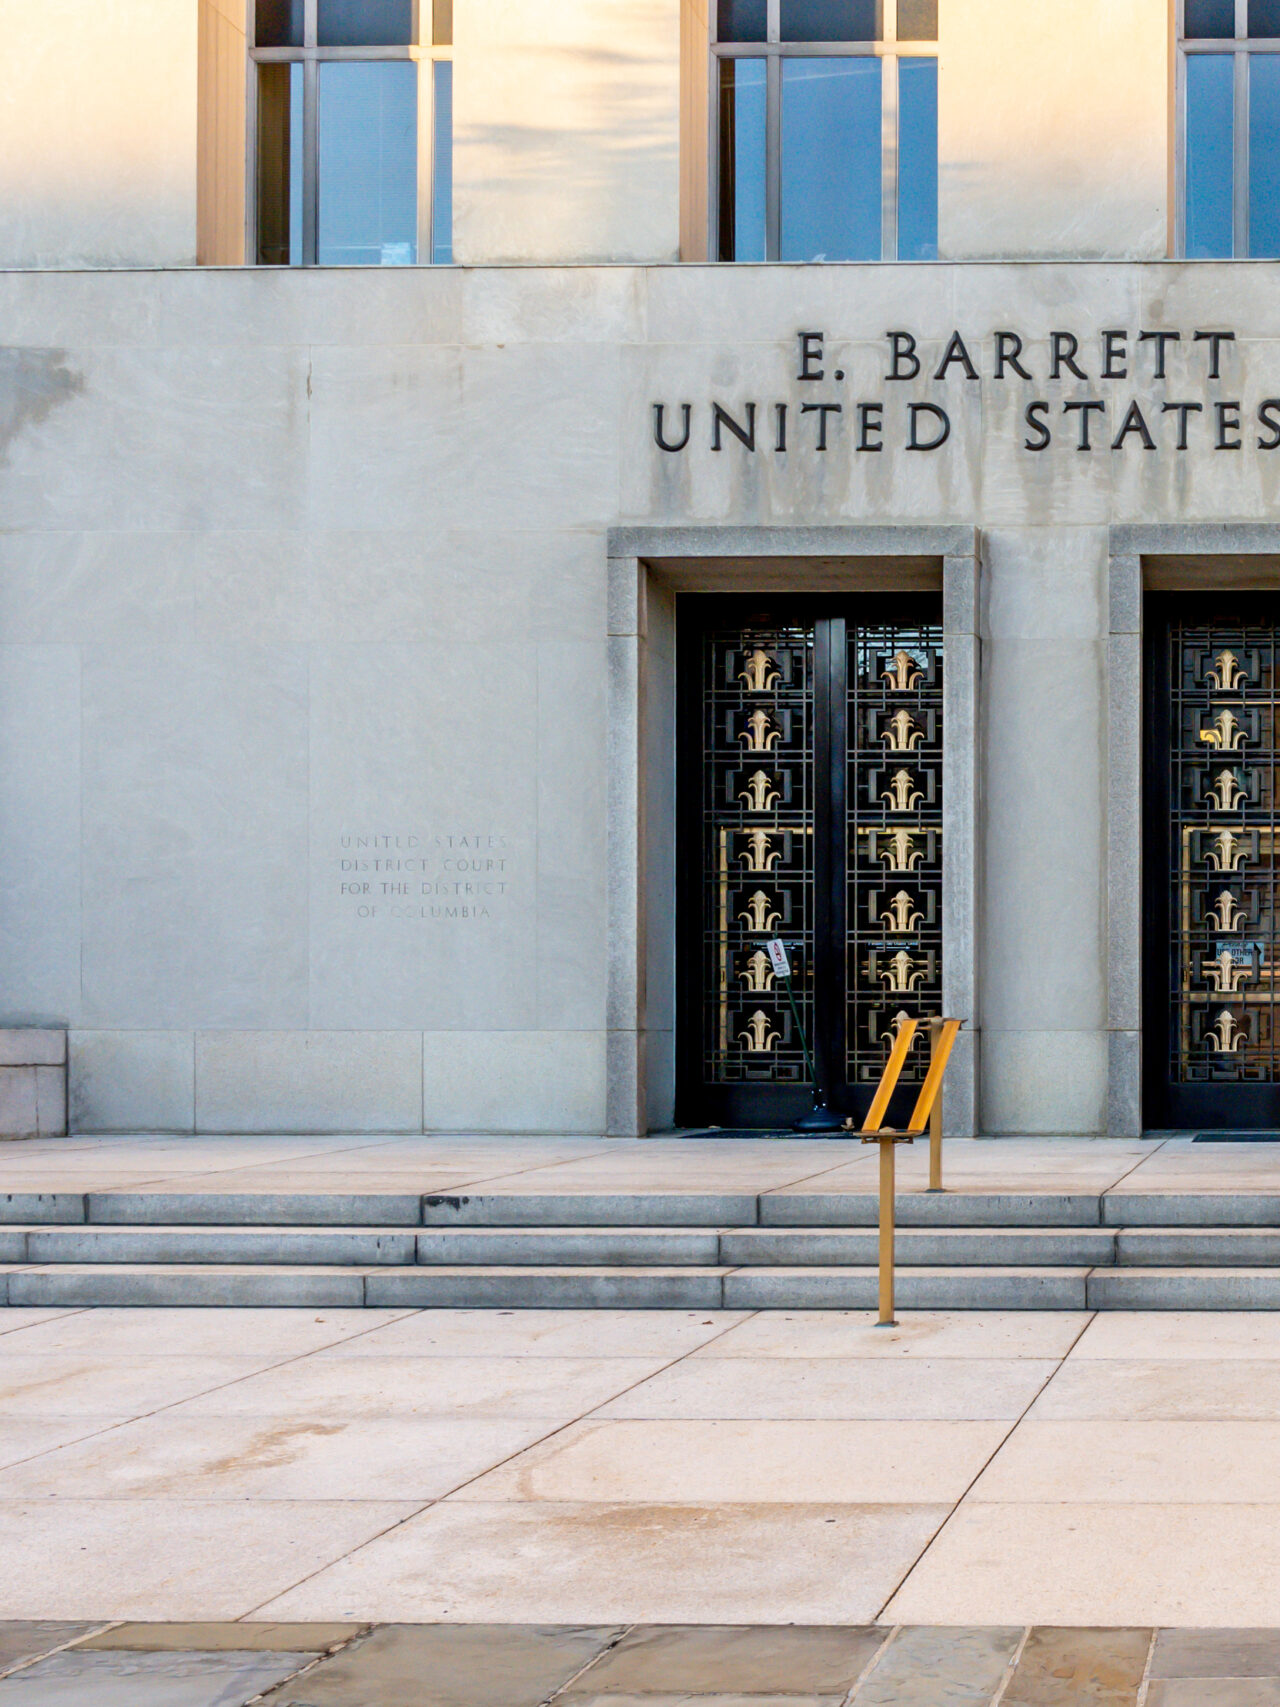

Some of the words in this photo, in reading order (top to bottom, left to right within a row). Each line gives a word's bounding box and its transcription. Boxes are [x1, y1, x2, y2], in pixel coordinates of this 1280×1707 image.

[796, 330, 846, 381] E.
[884, 329, 1236, 380] BARRETT
[652, 401, 951, 453] UNITED
[340, 835, 419, 849] UNITED
[434, 835, 508, 849] STATES
[340, 858, 428, 872] DISTRICT
[443, 858, 508, 872] COURT
[340, 881, 371, 895] FOR
[380, 881, 410, 895] THE
[421, 881, 508, 895] DISTRICT
[356, 905, 378, 918] OF
[389, 905, 490, 918] COLUMBIA
